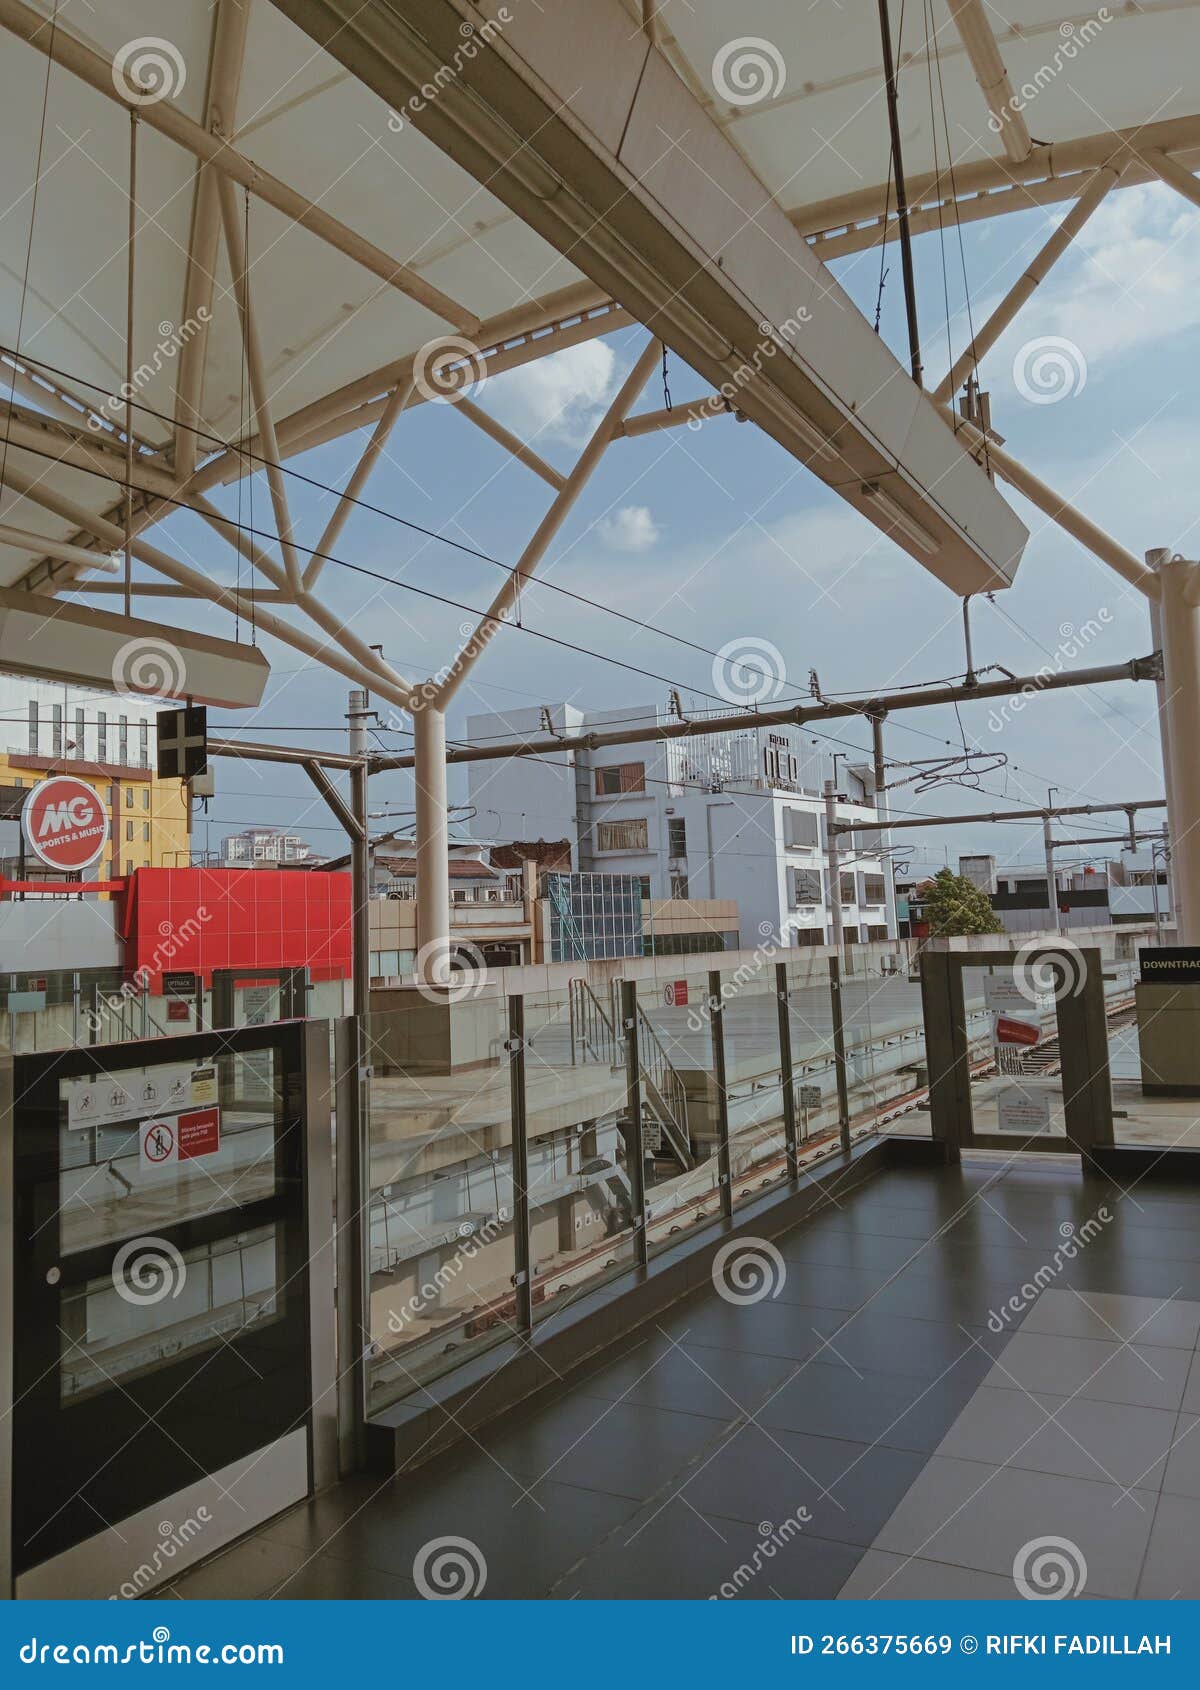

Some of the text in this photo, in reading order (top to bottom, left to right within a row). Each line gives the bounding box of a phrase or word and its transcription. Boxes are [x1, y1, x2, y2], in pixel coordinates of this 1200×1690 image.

[38, 796, 94, 837] MG
[36, 825, 105, 850] SPORTS & MUSIC
